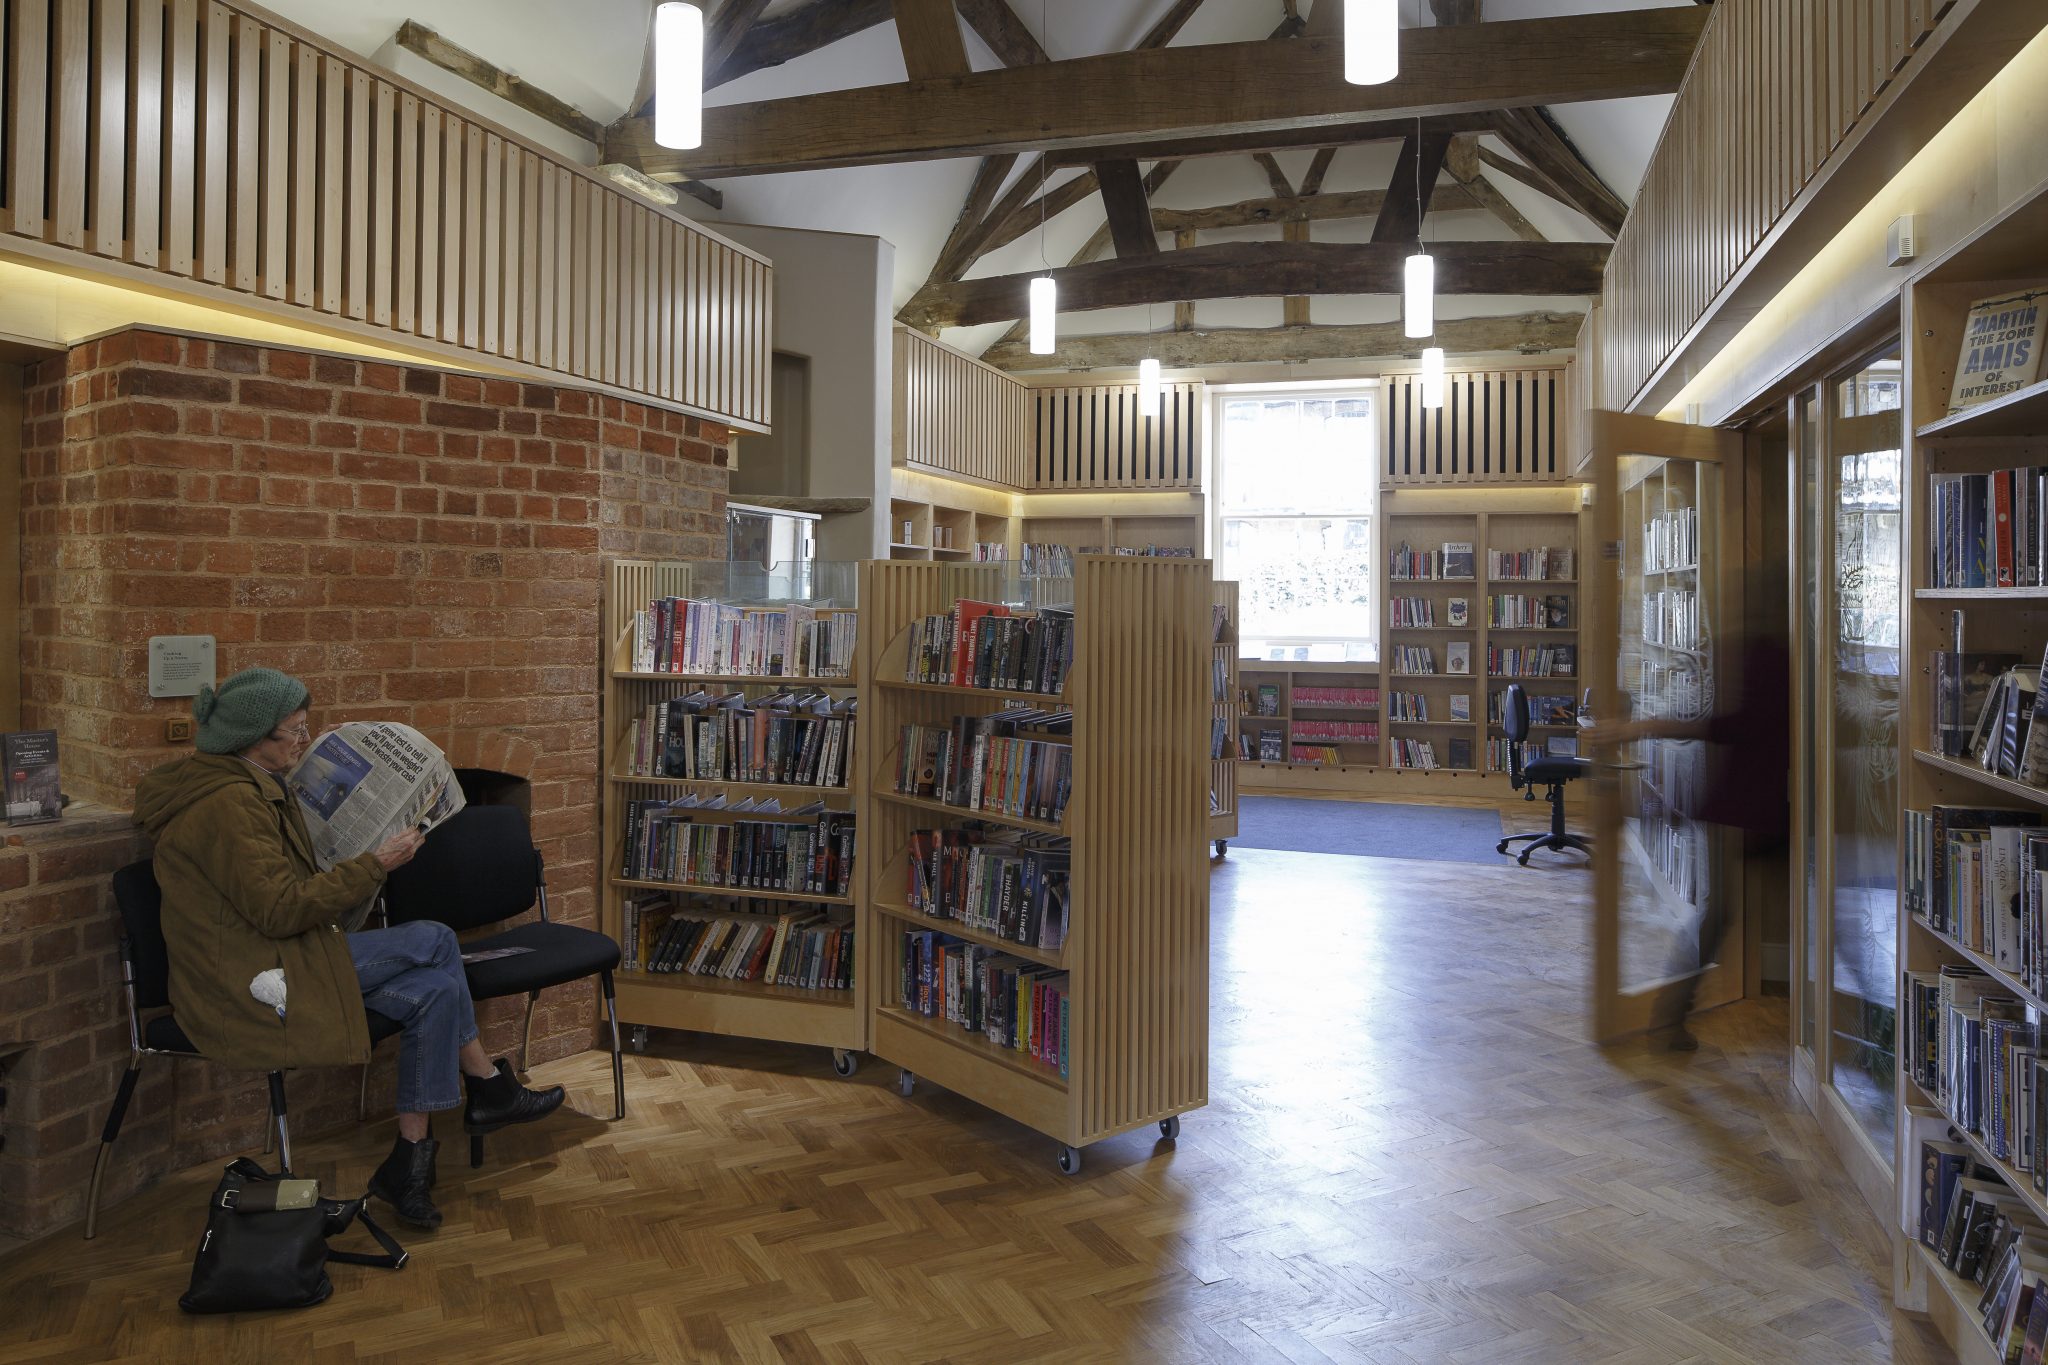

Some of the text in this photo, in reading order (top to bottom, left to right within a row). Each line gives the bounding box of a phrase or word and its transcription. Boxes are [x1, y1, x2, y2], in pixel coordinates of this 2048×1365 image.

[1972, 306, 2038, 335] MARTIN
[1970, 326, 2035, 347] THE ZONE
[1964, 339, 2032, 375] AMIS
[1960, 379, 2024, 399] INTEREST
[1984, 371, 2004, 382] OF
[952, 621, 960, 652] EVANOVICH
[380, 726, 397, 739] gene
[393, 735, 408, 748] test
[404, 743, 413, 752] to
[411, 749, 423, 761] tell
[381, 740, 395, 752] put
[392, 748, 401, 758] on
[400, 753, 423, 774] weight?
[361, 735, 415, 784] Don't waste your cash
[818, 821, 827, 847] Cornwell
[841, 835, 849, 858] Cornwell
[1933, 810, 1944, 879] PROXIMA
[1998, 847, 2007, 890] LINCOLN
[1002, 879, 1011, 911] HAYDER
